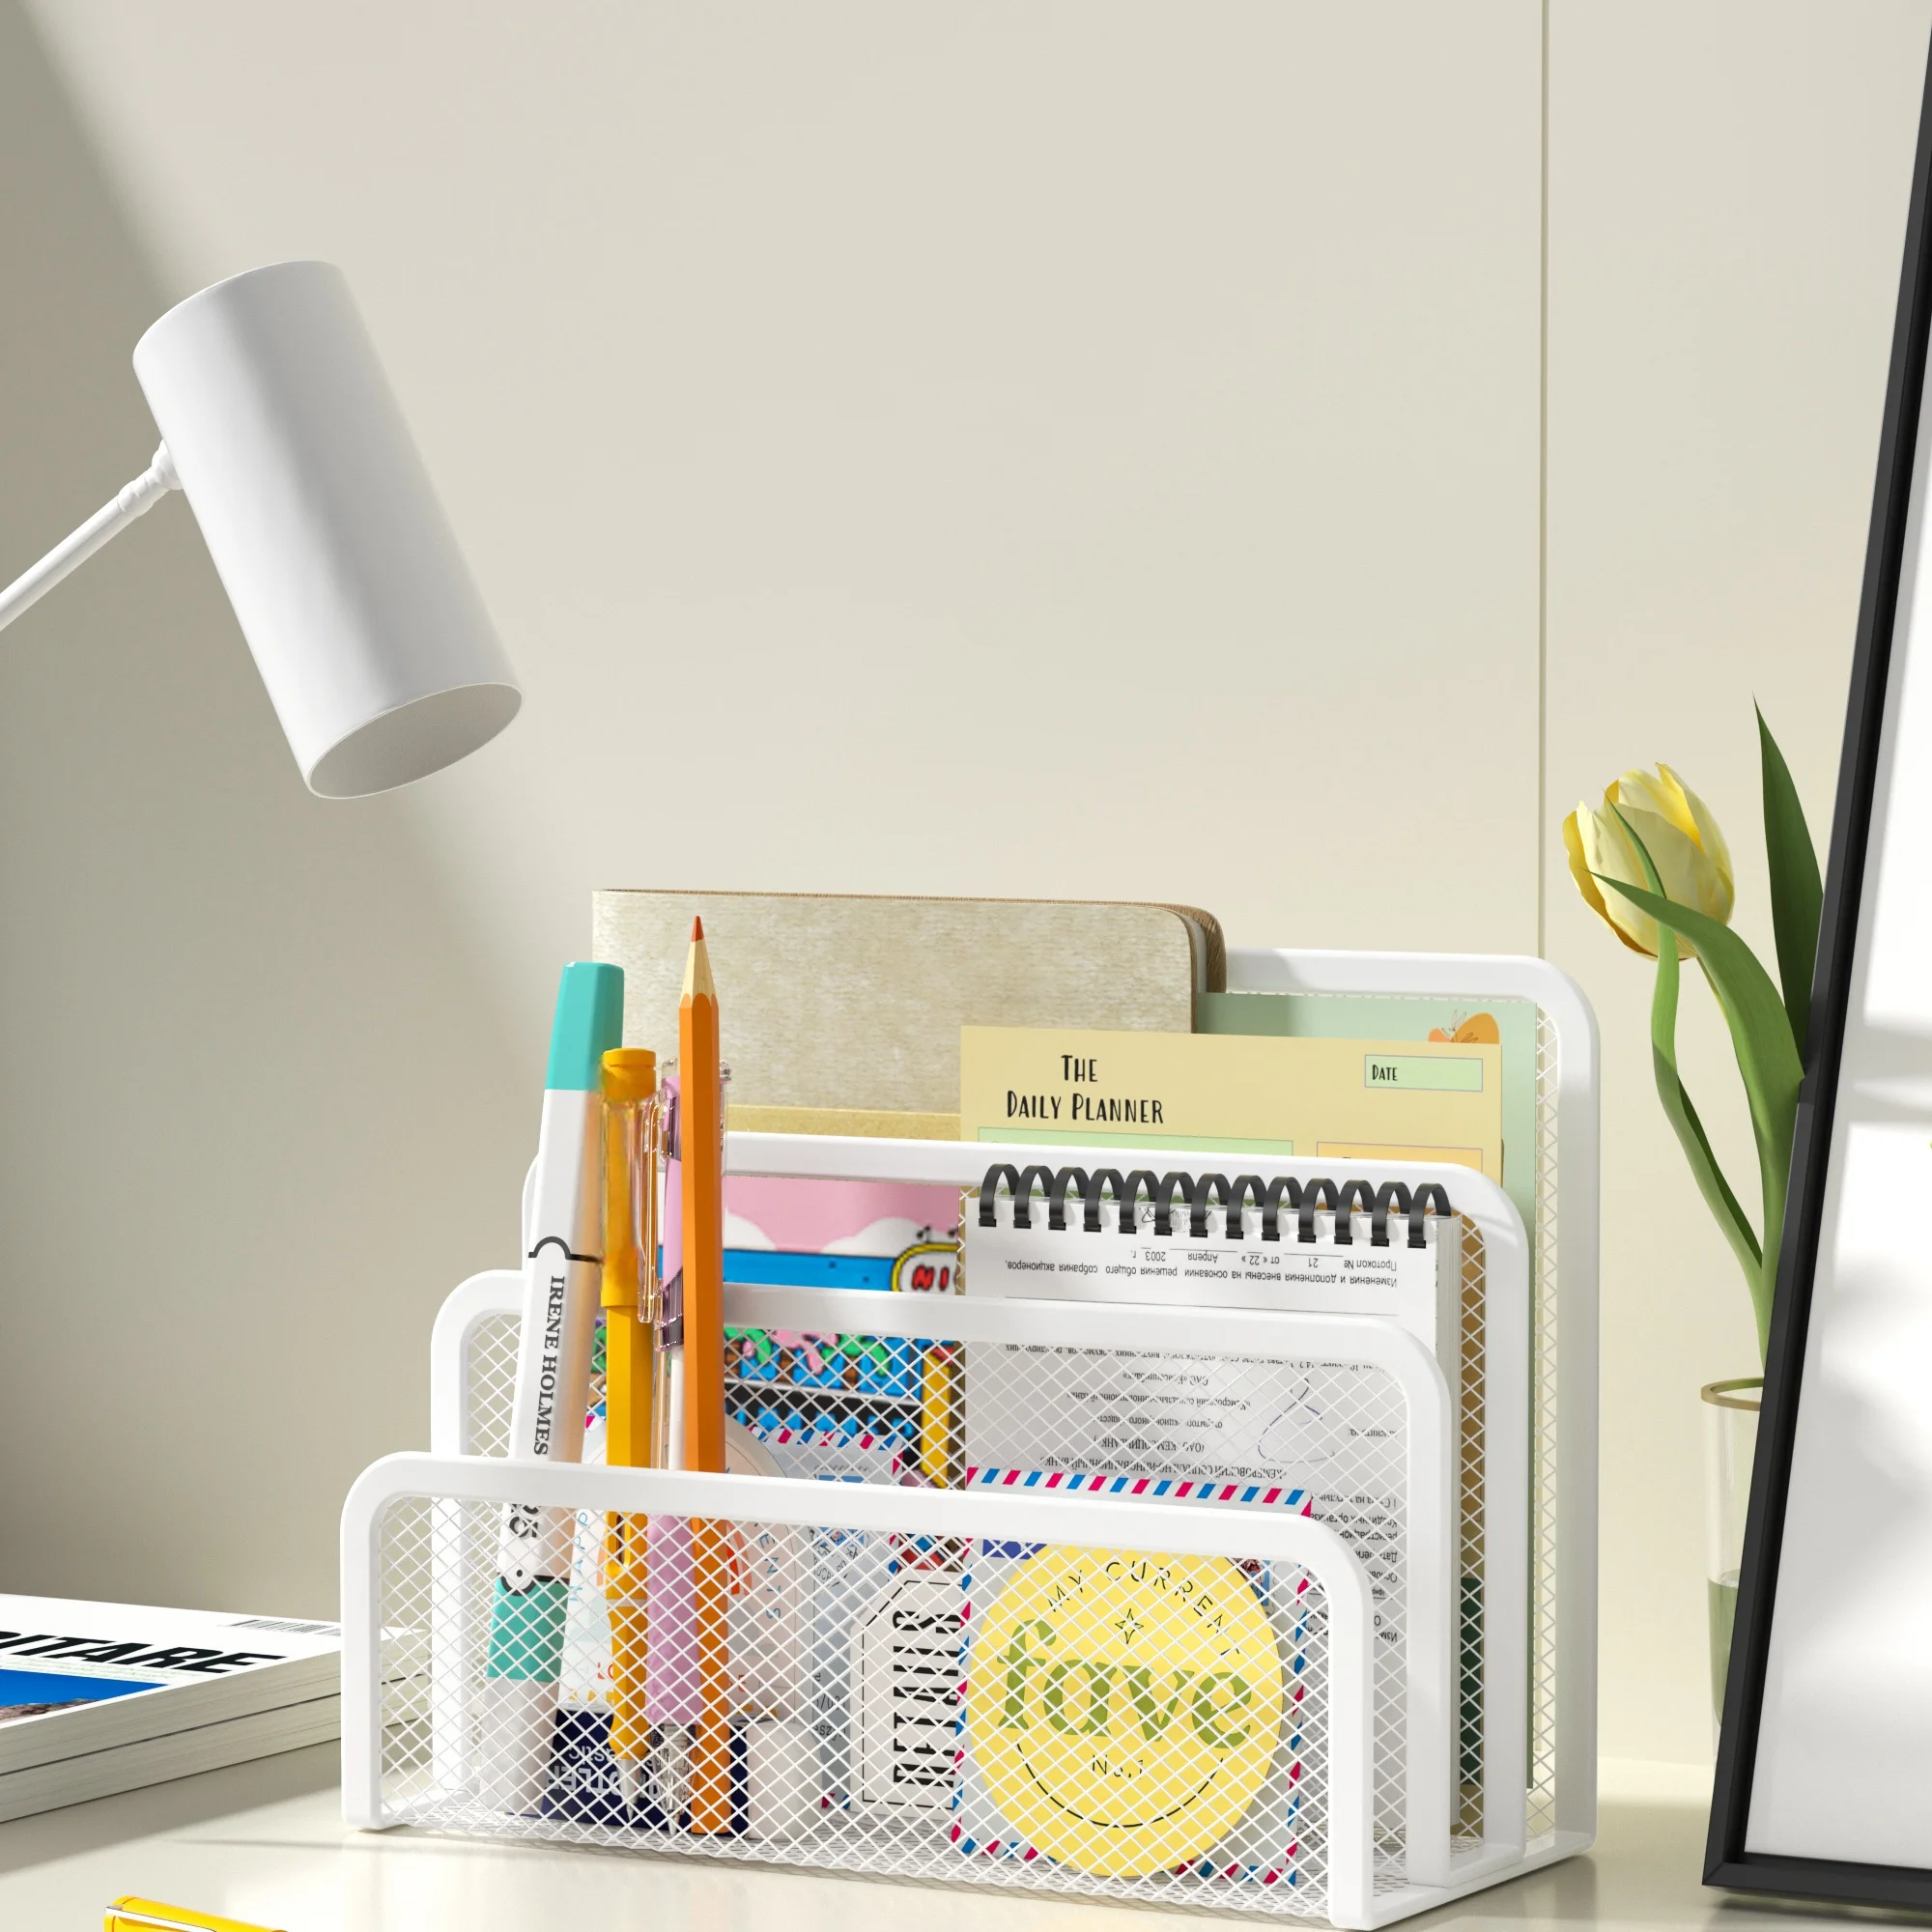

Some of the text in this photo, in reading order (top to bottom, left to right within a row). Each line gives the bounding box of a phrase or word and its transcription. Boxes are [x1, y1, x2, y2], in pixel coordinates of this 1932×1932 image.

[1061, 1054, 1098, 1083] THE
[1007, 1090, 1165, 1124] DAILY PLANNER
[1145, 1251, 1166, 1262] 2003
[1188, 1250, 1218, 1263] Апреля
[1271, 1256, 1279, 1264] от
[1308, 1258, 1319, 1267] 21
[1357, 1260, 1397, 1271] Протокол
[1059, 1263, 1097, 1274] собрания
[1106, 1264, 1136, 1277] общего
[1141, 1265, 1177, 1276] решения
[1184, 1269, 1228, 1278] основании
[1245, 1271, 1281, 1280] внесены
[1285, 1273, 1336, 1284] дополнения
[1350, 1276, 1397, 1288] Изменения
[532, 1275, 565, 1456] IRENE HOLMES
[997, 1619, 1252, 1749] fave
